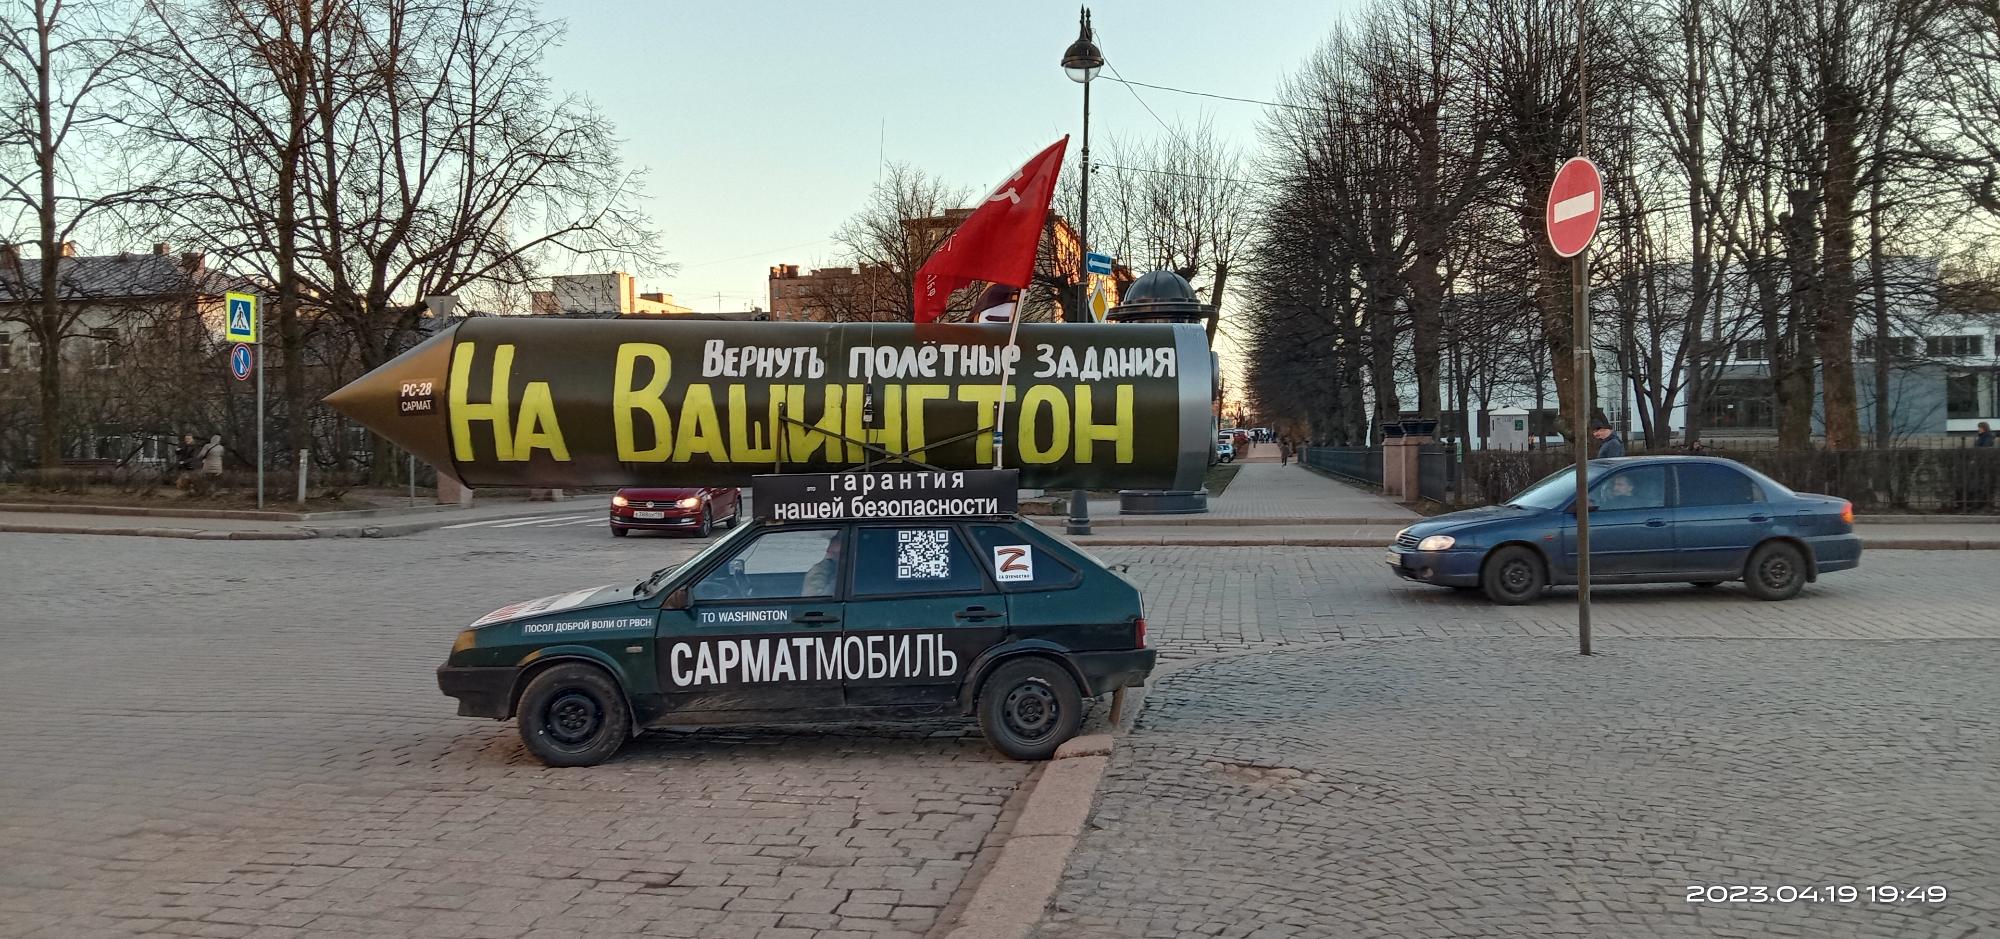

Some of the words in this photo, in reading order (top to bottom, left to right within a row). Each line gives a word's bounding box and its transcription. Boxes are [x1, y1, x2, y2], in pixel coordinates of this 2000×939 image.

[1033, 343, 1176, 381] ЗАДАНИЯ
[401, 383, 432, 397] РС-28
[401, 400, 432, 412] САРМАТ
[830, 472, 964, 495] гарантия
[774, 497, 844, 519] нашей
[851, 496, 998, 517] безопасности
[525, 623, 555, 633] ПОСОЛ
[556, 619, 590, 633] ДОБРОЙ
[592, 620, 615, 630] ВОЛИ
[617, 619, 627, 629] ОТ
[630, 618, 652, 628] РВСН
[702, 612, 716, 623] TO
[719, 609, 788, 622] WASHINGTON
[670, 633, 958, 687] САРМАТМОБИЛЬ
